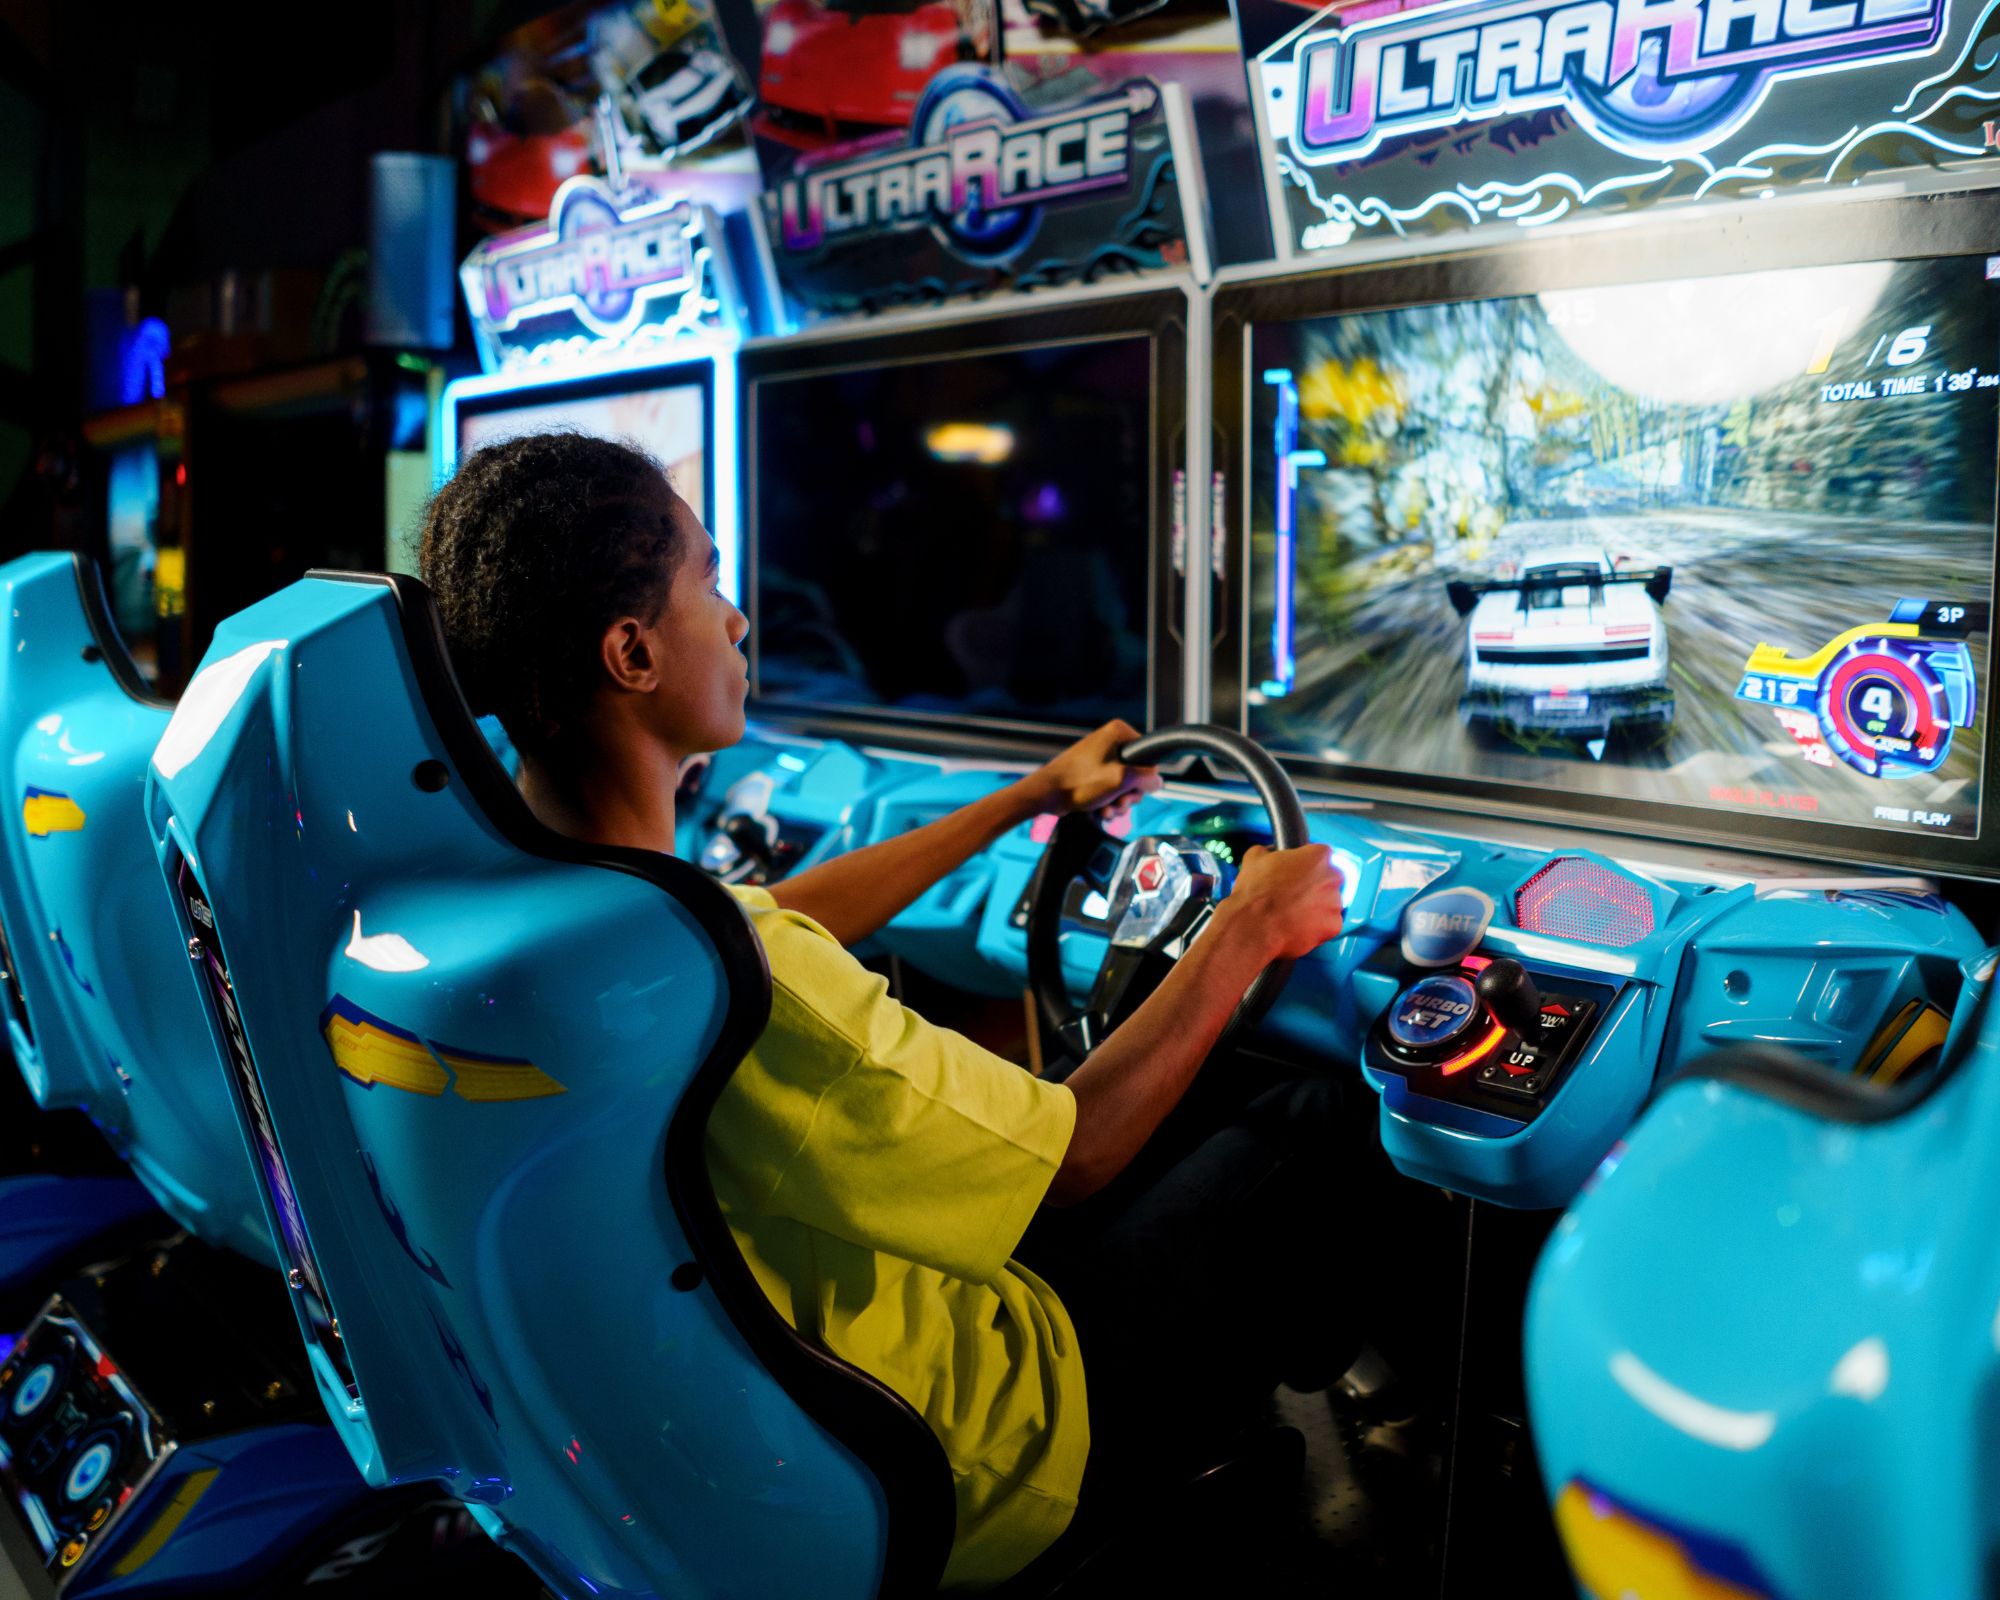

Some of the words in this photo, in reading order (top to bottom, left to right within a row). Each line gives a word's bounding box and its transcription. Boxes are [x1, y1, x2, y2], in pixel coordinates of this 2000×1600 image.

[1821, 380, 1876, 402] TOTAL
[1880, 374, 1928, 397] TIME
[1937, 607, 1965, 623] 3P
[1861, 687, 1892, 721] 4
[1913, 810, 1952, 827] PLAY
[1413, 911, 1476, 933] START
[1406, 993, 1470, 1016] TURBO
[1400, 1008, 1452, 1029] JET
[1509, 1051, 1535, 1067] UP
